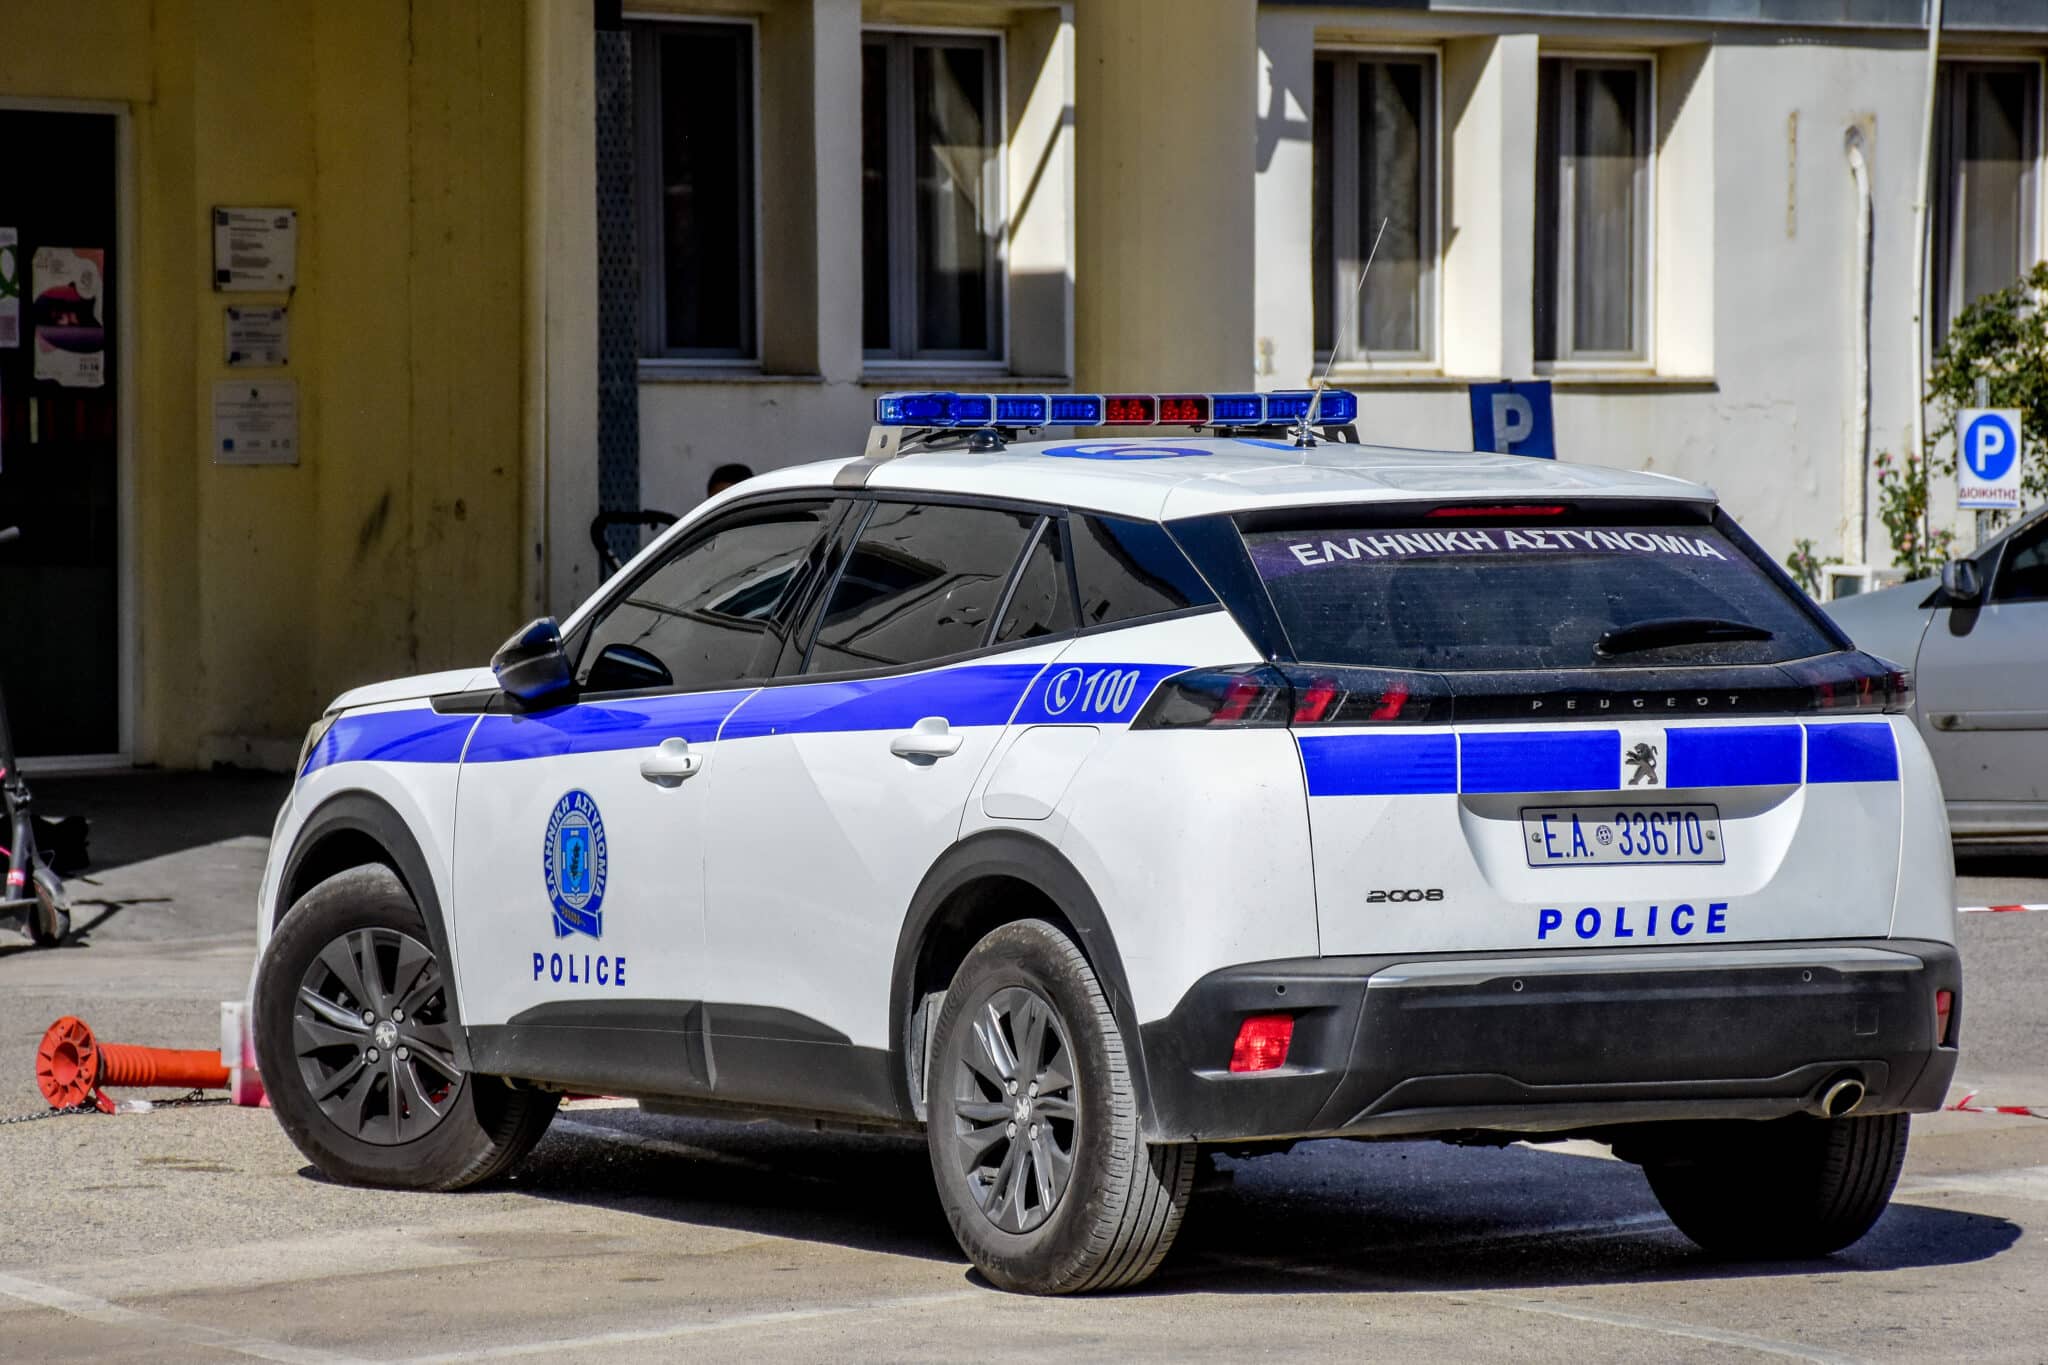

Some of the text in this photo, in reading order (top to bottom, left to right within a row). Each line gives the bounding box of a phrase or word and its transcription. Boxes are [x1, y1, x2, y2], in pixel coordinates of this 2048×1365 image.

[1491, 393, 1534, 455] P
[1976, 425, 2006, 472] P
[1288, 529, 1728, 566] ΕΛΛΗΝΙΚΗ ΑΣΤΥΝΟΜΙΑ
[1081, 668, 1140, 714] 100
[1532, 695, 1739, 710] PEUGEOT
[1615, 811, 1704, 856] 33670
[1366, 888, 1445, 904] 2008
[1537, 902, 1729, 940] POLICE
[533, 952, 626, 987] POLICE
